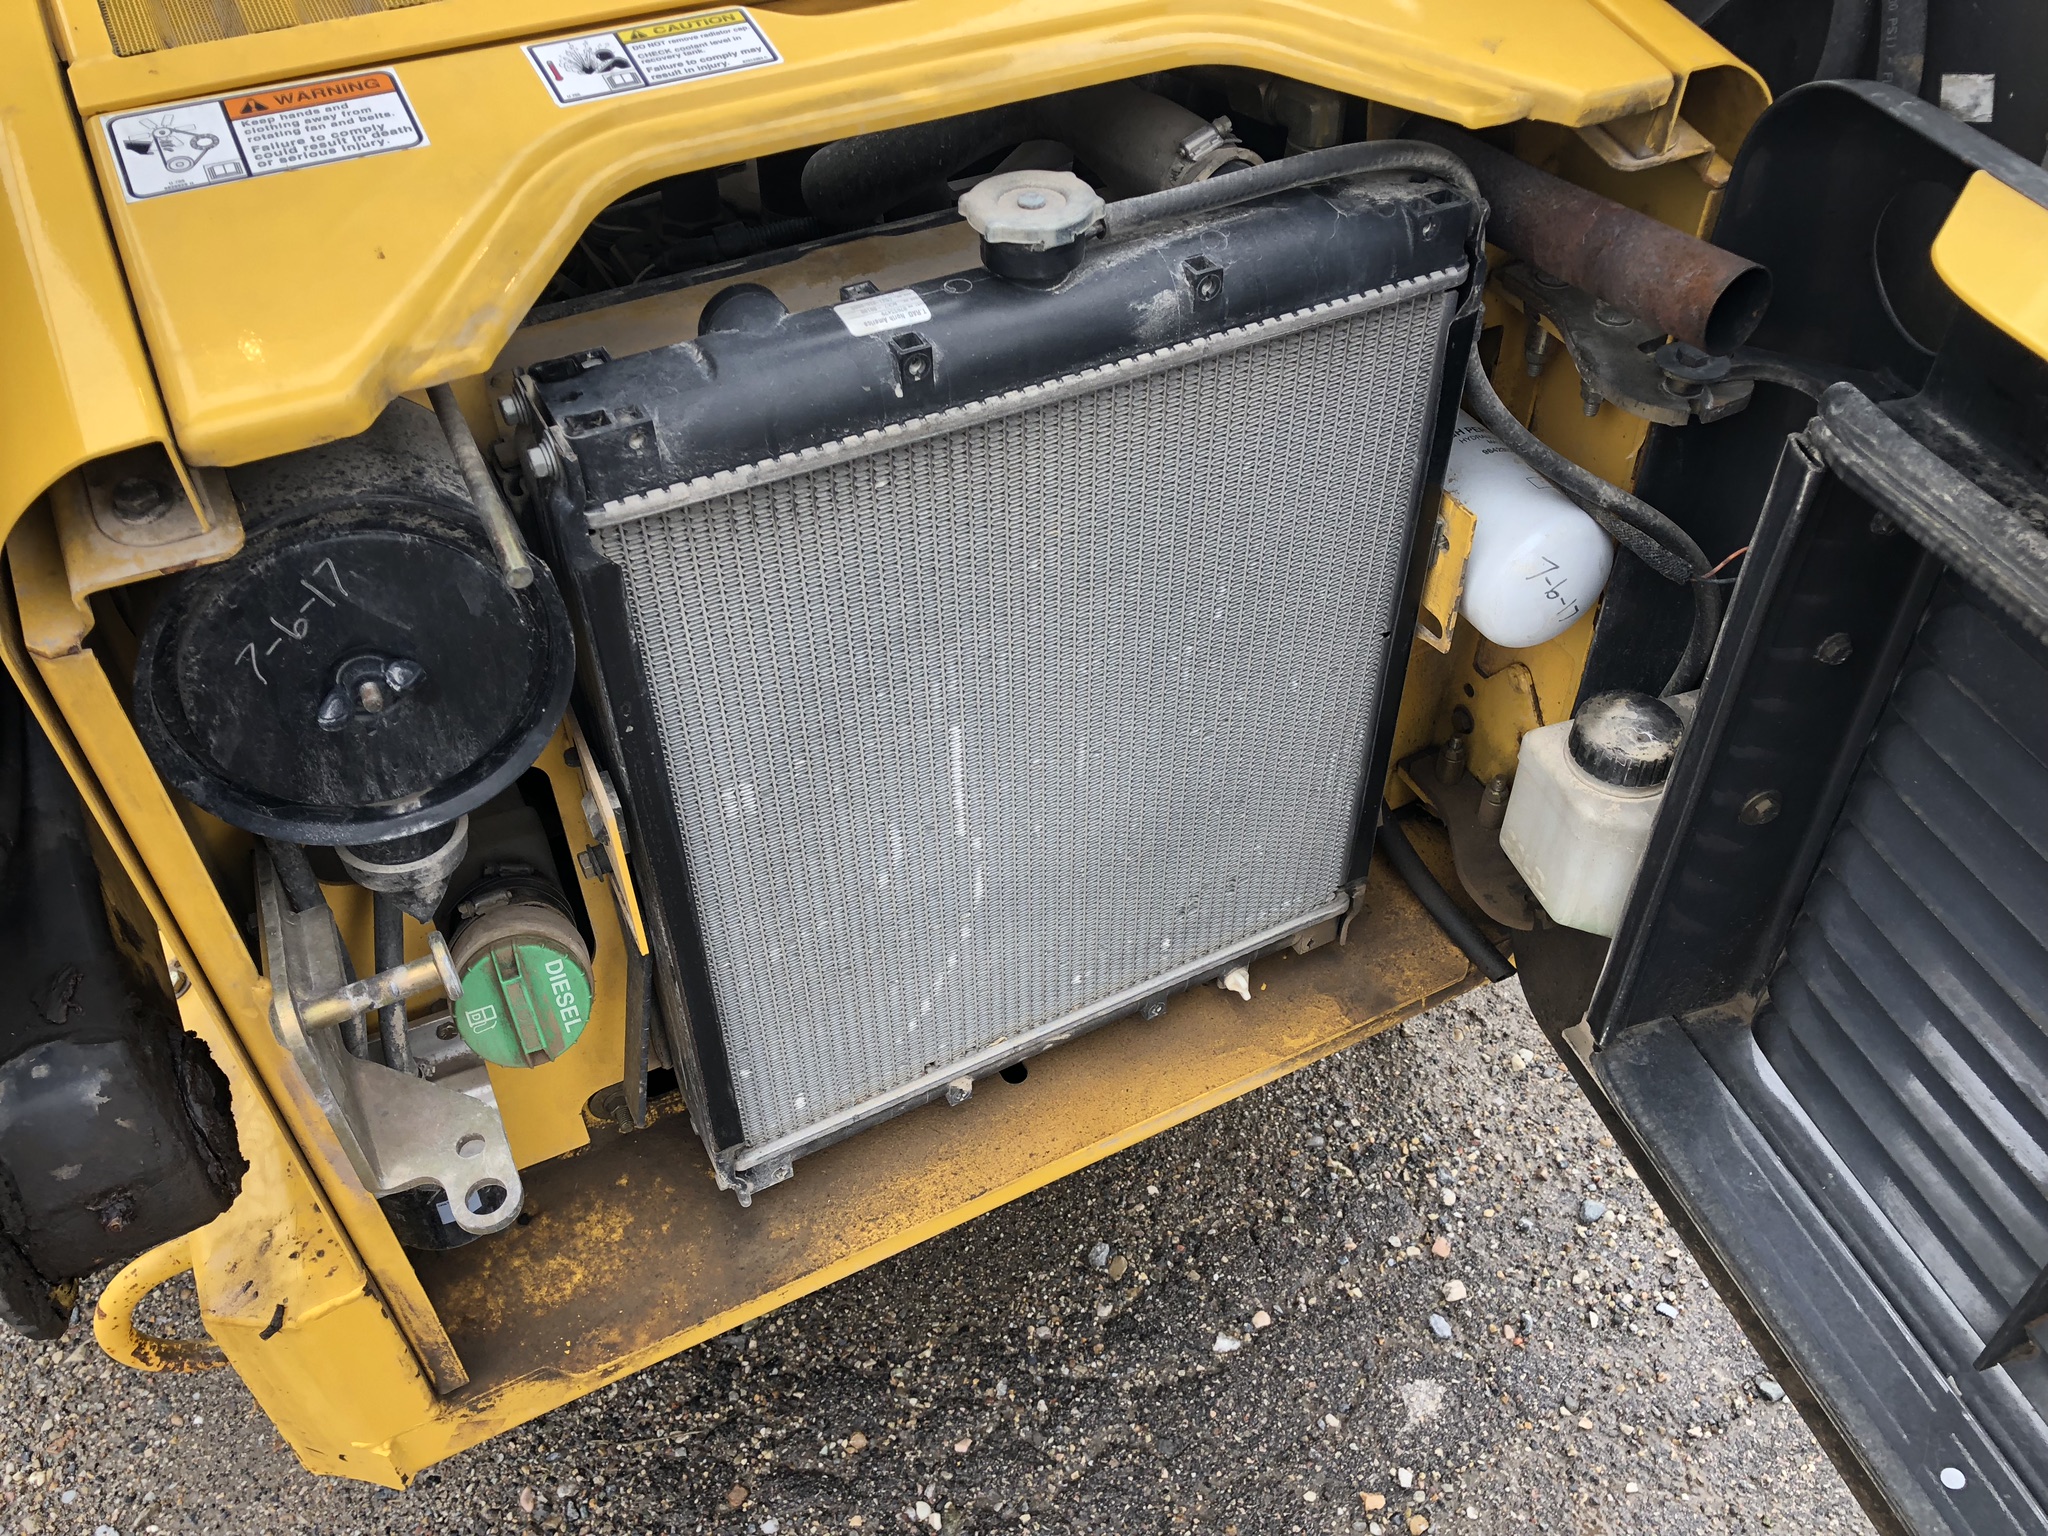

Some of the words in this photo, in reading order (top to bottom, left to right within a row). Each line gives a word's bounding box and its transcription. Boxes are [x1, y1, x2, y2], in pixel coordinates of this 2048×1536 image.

[647, 41, 666, 49] NOT
[668, 35, 699, 44] remove
[700, 28, 731, 39] radiator
[733, 26, 751, 34] cap.
[652, 13, 736, 34] CAUTION
[637, 48, 672, 60] CHECK
[674, 42, 709, 52] coolant
[710, 38, 732, 46] level
[641, 53, 681, 65] recovery
[682, 48, 706, 57] tank.
[646, 61, 685, 74] Failure
[685, 58, 697, 66] to
[699, 51, 738, 64] comply
[740, 46, 762, 56] may
[650, 70, 683, 81] result
[684, 67, 695, 75] in
[697, 61, 731, 72] injury.
[273, 78, 381, 106] WARNING
[241, 116, 276, 128] Keep
[280, 108, 321, 122] hands
[325, 103, 349, 113] and
[244, 119, 301, 136] clothing
[304, 113, 338, 125] away
[342, 106, 372, 118] from
[247, 127, 302, 143] rotating
[305, 122, 326, 133] fan
[330, 117, 355, 128] and
[359, 111, 396, 123] belts.
[251, 138, 306, 154] Failure
[310, 134, 326, 143] to
[331, 123, 386, 140] comply
[254, 146, 299, 161] could
[303, 137, 348, 152] result
[352, 133, 367, 143] in
[371, 125, 414, 139] death
[257, 159, 274, 169] or
[279, 147, 338, 164] serious
[342, 138, 392, 153] injury.
[863, 317, 889, 328] America
[888, 313, 907, 322] North
[1525, 556, 1580, 622] 7-6-17
[234, 557, 349, 686] 7-6-17
[544, 958, 582, 1034] DIESEL
